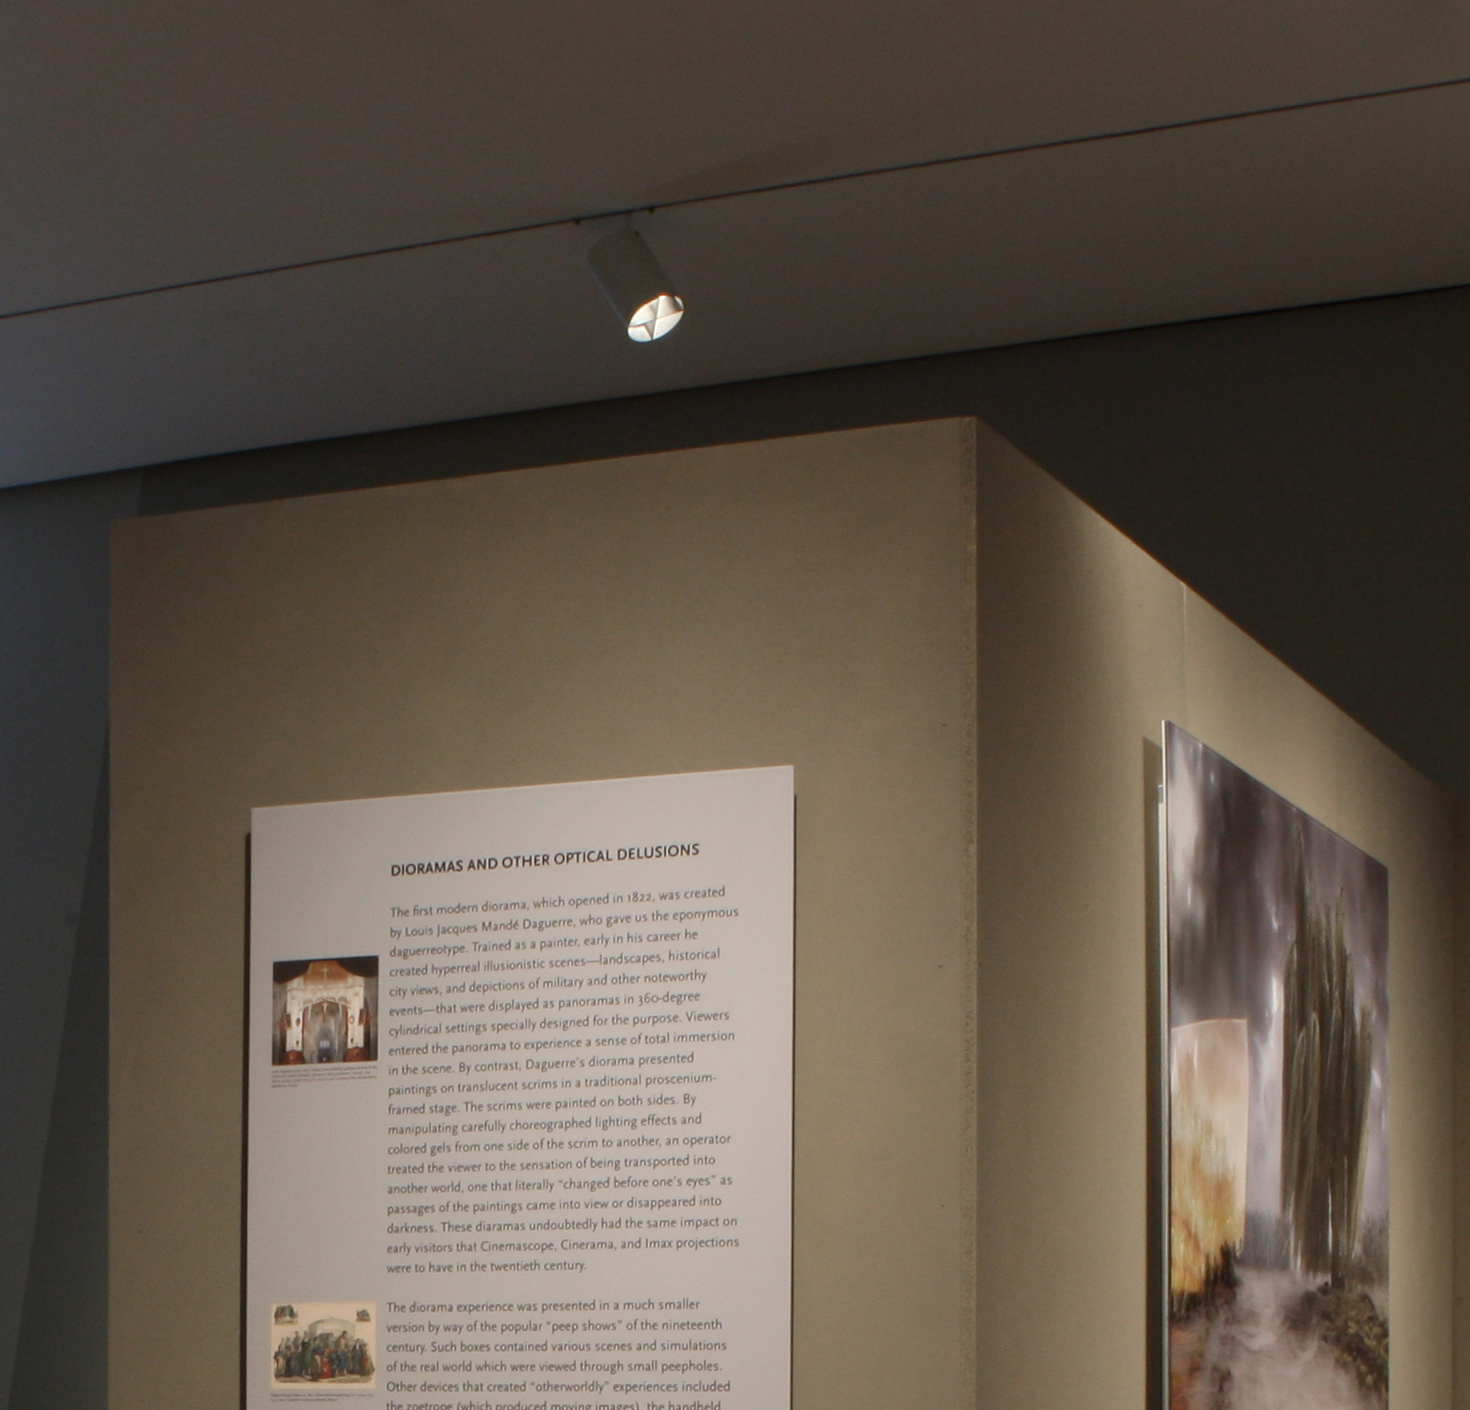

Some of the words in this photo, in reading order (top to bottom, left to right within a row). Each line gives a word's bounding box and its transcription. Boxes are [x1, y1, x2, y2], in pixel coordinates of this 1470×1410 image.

[391, 860, 463, 877] DIORAMAS
[467, 857, 498, 871] AND
[502, 854, 550, 869] OTHER
[554, 849, 613, 865] OPTICAL
[617, 843, 699, 861] DELUSIONS
[390, 906, 410, 918] The
[413, 904, 433, 916] first
[436, 902, 478, 914] modern
[481, 900, 530, 912] diorama,
[533, 895, 565, 909] which
[568, 892, 610, 909] opened
[613, 895, 623, 903] in
[627, 891, 655, 903] 1822,
[658, 891, 680, 901] was
[683, 885, 725, 899] created
[390, 927, 402, 940] by
[405, 927, 434, 937] Louis
[437, 924, 478, 938] Jacques
[482, 919, 519, 932] Mandé
[523, 918, 576, 932] Daguerre,
[579, 914, 603, 926] who
[606, 915, 632, 928] gave
[635, 914, 648, 923] us
[651, 910, 669, 922] the
[672, 908, 739, 923] eponymous
[389, 945, 468, 960] daguerreotype.
[472, 939, 512, 952] Trained
[514, 941, 527, 950] as
[530, 941, 536, 949] a
[540, 938, 580, 952] painter,
[583, 933, 610, 948] early
[613, 936, 624, 944] in
[627, 932, 643, 943] his
[646, 932, 681, 942] career
[684, 928, 698, 940] he
[389, 987, 407, 999] city
[410, 986, 442, 996] views,
[446, 982, 466, 994] and
[469, 981, 525, 995] depictions
[528, 977, 541, 990] of
[542, 977, 584, 990] military
[587, 973, 608, 986] and
[611, 973, 640, 985] other
[644, 969, 707, 983] noteworthy
[388, 1022, 442, 1039] cylindrical
[445, 1023, 487, 1036] settings
[491, 1018, 537, 1034] specially
[539, 1015, 590, 1031] designed
[593, 1014, 609, 1026] for
[611, 1014, 629, 1026] the
[632, 1014, 682, 1028] purpose.
[685, 1011, 730, 1022] Viewers
[388, 1085, 437, 1098] paintings
[440, 1085, 454, 1093] on
[457, 1080, 518, 1093] translucent
[521, 1080, 558, 1090] scrims
[561, 1080, 572, 1088] in
[575, 1080, 581, 1088] a
[584, 1074, 642, 1088] traditional
[645, 1074, 716, 1088] proscenium-
[388, 1103, 425, 1115] framed
[429, 1104, 460, 1117] stage.
[463, 1101, 483, 1112] The
[487, 1102, 523, 1112] scrims
[526, 1101, 552, 1110] were
[555, 1096, 596, 1112] painted
[599, 1099, 614, 1107] on
[618, 1094, 643, 1107] both
[647, 1094, 678, 1106] sides.
[683, 1093, 696, 1107] By
[388, 1122, 458, 1137] manipulating
[461, 1120, 506, 1134] carefully
[509, 1116, 592, 1133] choreographed
[595, 1115, 637, 1131] lighting
[640, 1113, 677, 1126] effects
[681, 1112, 702, 1125] and
[387, 1222, 437, 1234] darkness.
[441, 1221, 472, 1232] These
[475, 1221, 526, 1232] diaramas
[529, 1218, 598, 1232] undoubtedly
[601, 1217, 622, 1229] had
[625, 1217, 643, 1229] the
[646, 1219, 677, 1228] same
[680, 1217, 719, 1230] impact
[722, 1218, 738, 1227] on
[387, 1242, 412, 1256] early
[414, 1244, 453, 1253] visitors
[456, 1241, 477, 1252] that
[480, 1241, 557, 1254] Cinemascope,
[560, 1239, 617, 1250] Cinerama,
[620, 1237, 642, 1249] and
[645, 1238, 672, 1249] Imax
[676, 1238, 740, 1251] projections
[386, 1302, 407, 1313] The
[409, 1301, 453, 1313] diorama
[456, 1303, 514, 1315] experience
[517, 1303, 538, 1312] was
[541, 1299, 596, 1314] presented
[599, 1302, 610, 1310] in
[613, 1302, 619, 1310] a
[623, 1298, 655, 1311] much
[659, 1298, 700, 1310] smaller
[386, 1343, 427, 1355] century.
[431, 1340, 457, 1353] Such
[460, 1340, 491, 1352] boxes
[494, 1340, 548, 1352] contained
[551, 1343, 591, 1352] various
[595, 1343, 632, 1351] scenes
[636, 1339, 657, 1351] and
[660, 1339, 727, 1351] simulations
